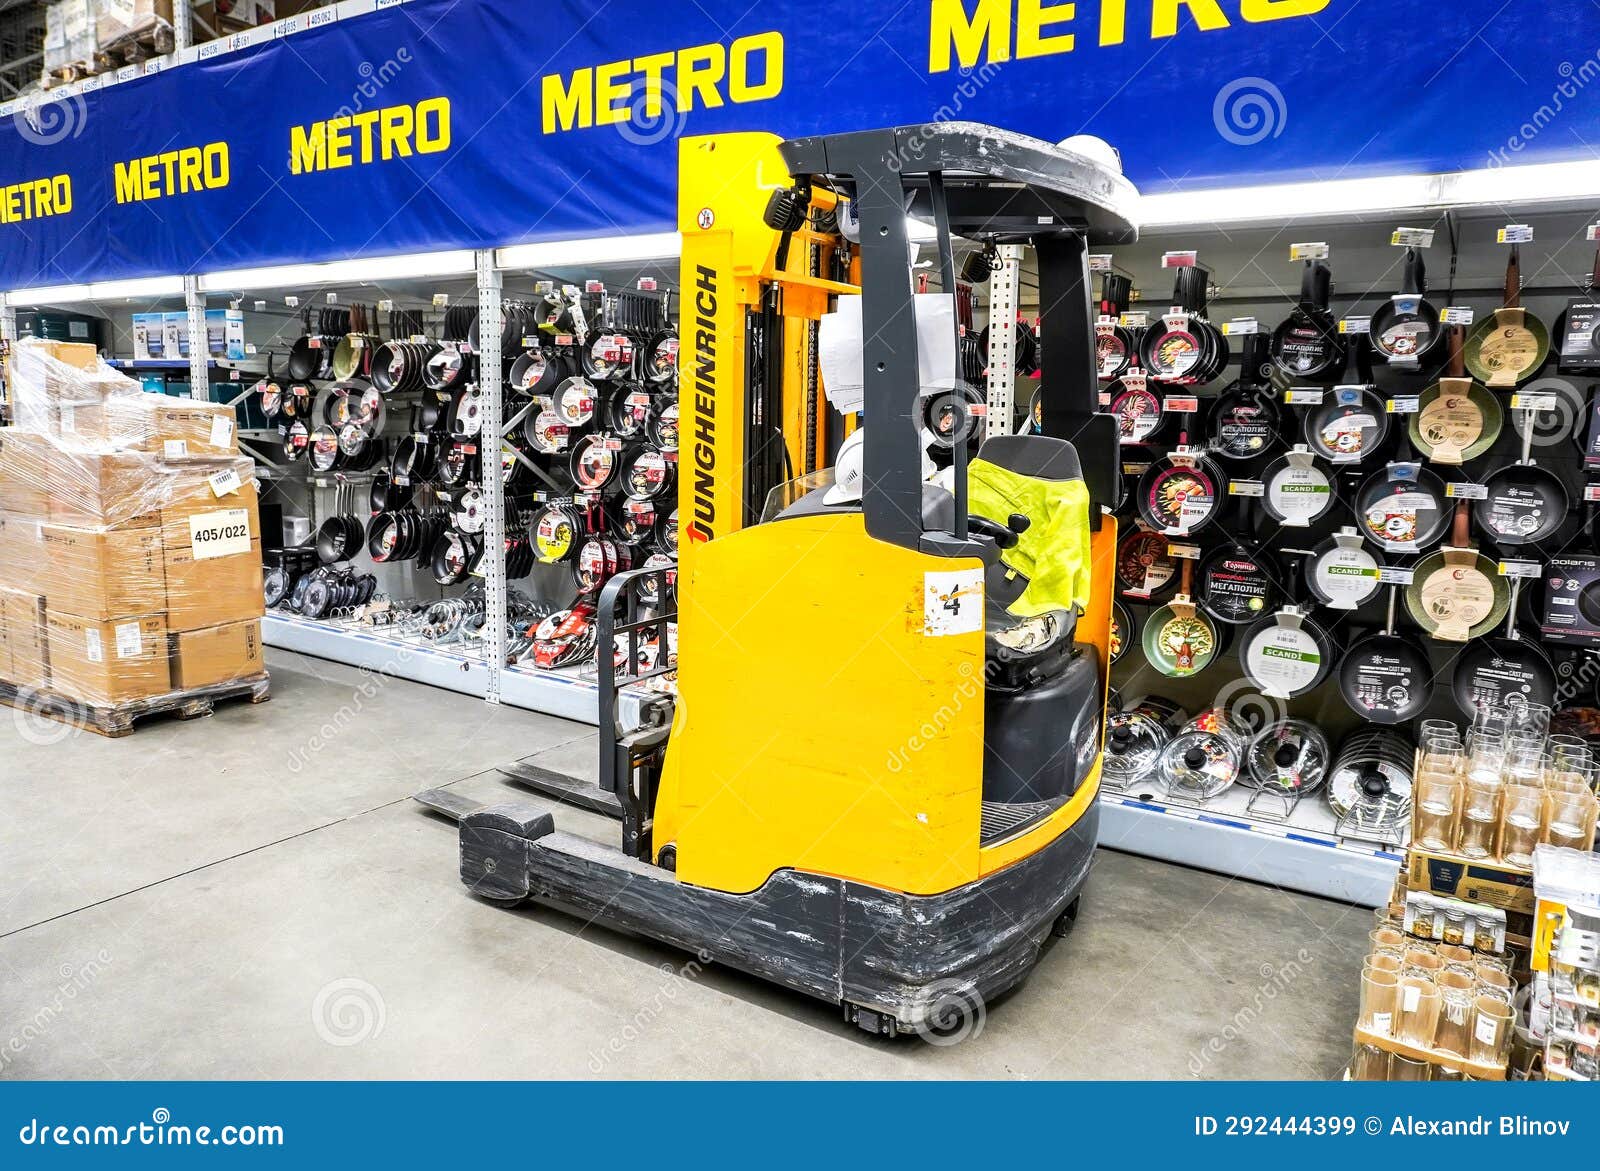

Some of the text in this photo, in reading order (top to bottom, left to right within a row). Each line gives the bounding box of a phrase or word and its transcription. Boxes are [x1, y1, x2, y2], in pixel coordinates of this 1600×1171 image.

[541, 30, 783, 134] METRO
[291, 97, 450, 175] METRO
[115, 142, 229, 204] METRO
[694, 264, 717, 542] JUNGHEINRICH
[194, 525, 247, 542] 405/022
[1330, 567, 1363, 575] SCANDI
[1551, 559, 1596, 567] polaris
[942, 584, 961, 616] 4
[1210, 581, 1266, 595] МЕГАПОЛИС
[1266, 648, 1303, 660] SCANDI
